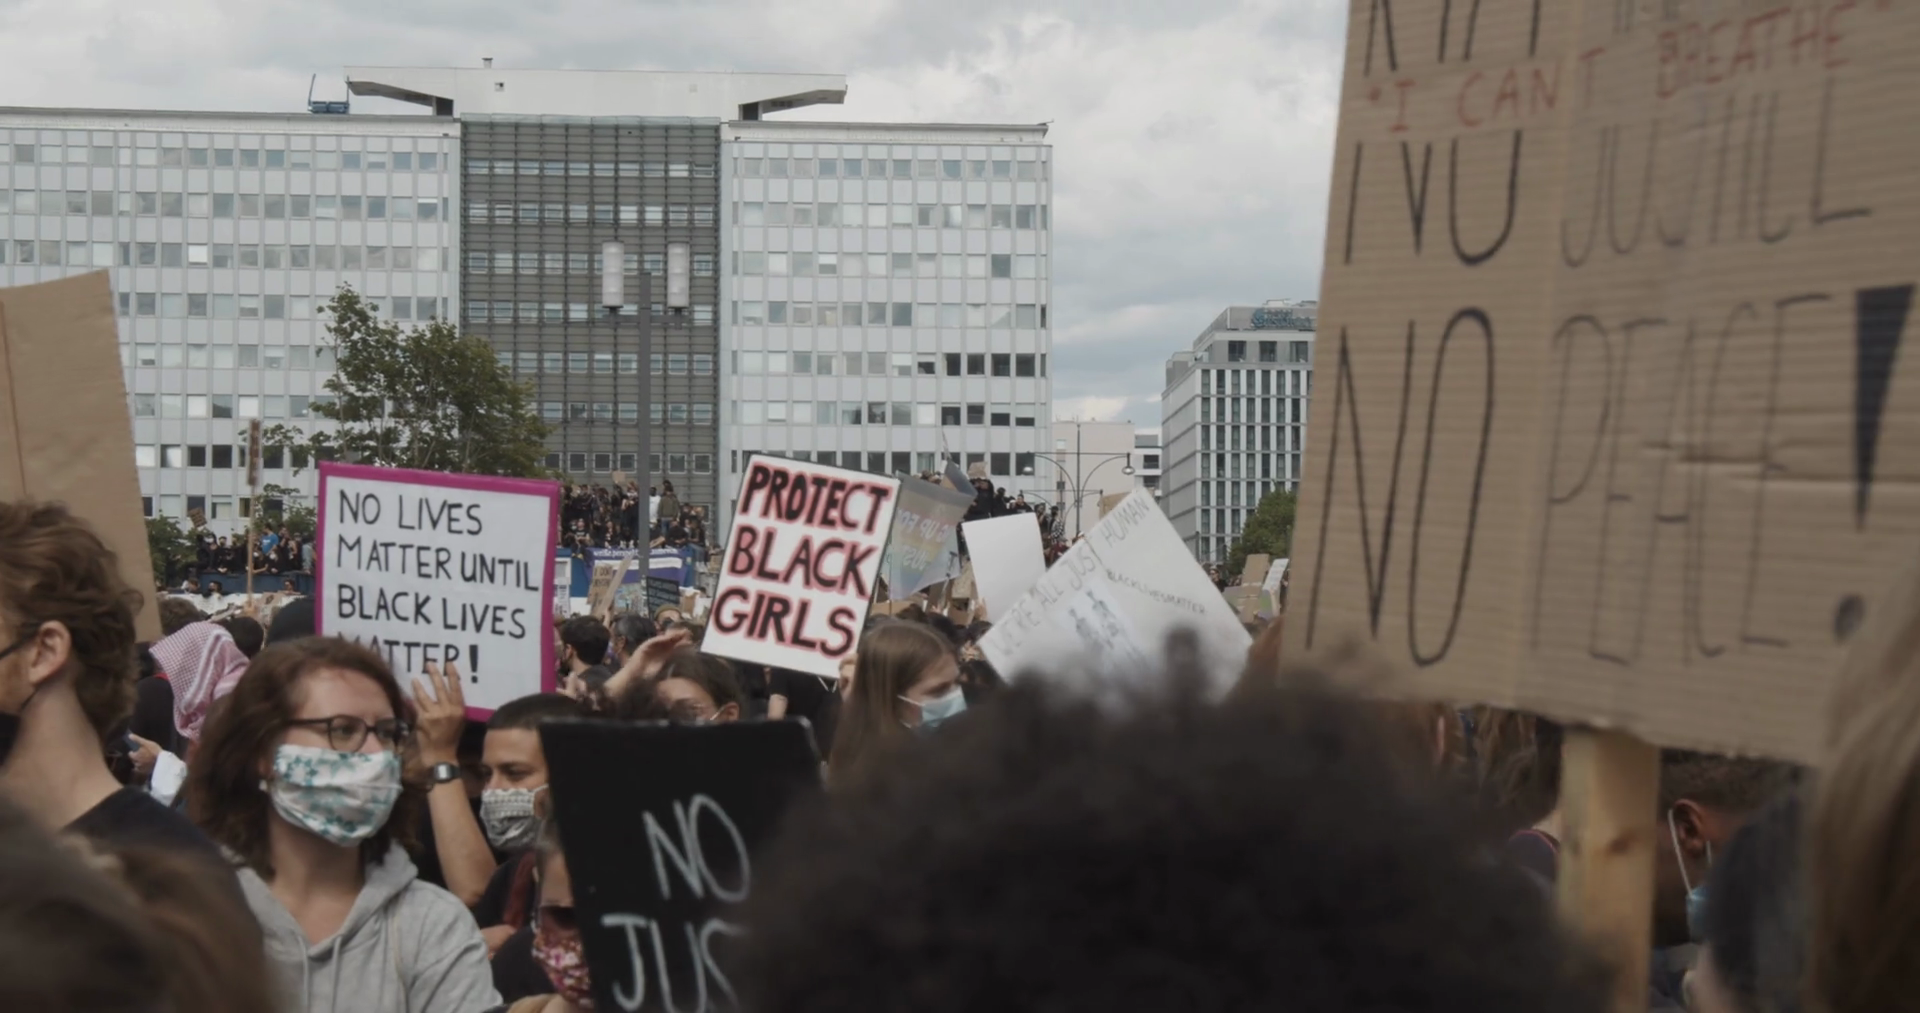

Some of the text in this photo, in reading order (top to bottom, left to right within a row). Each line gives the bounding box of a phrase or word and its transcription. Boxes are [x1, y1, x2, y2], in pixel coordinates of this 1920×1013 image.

[339, 489, 483, 536] NO LIVES
[739, 464, 892, 534] PROTECT
[1100, 494, 1151, 549] HUMAN
[1305, 306, 1495, 667] NO
[337, 534, 539, 592] MATTER UNTIL
[728, 526, 878, 600] BLACK
[337, 584, 431, 626] BLACK
[442, 598, 526, 639] LIVES
[712, 587, 858, 658] GIRLS
[642, 793, 751, 901] NO
